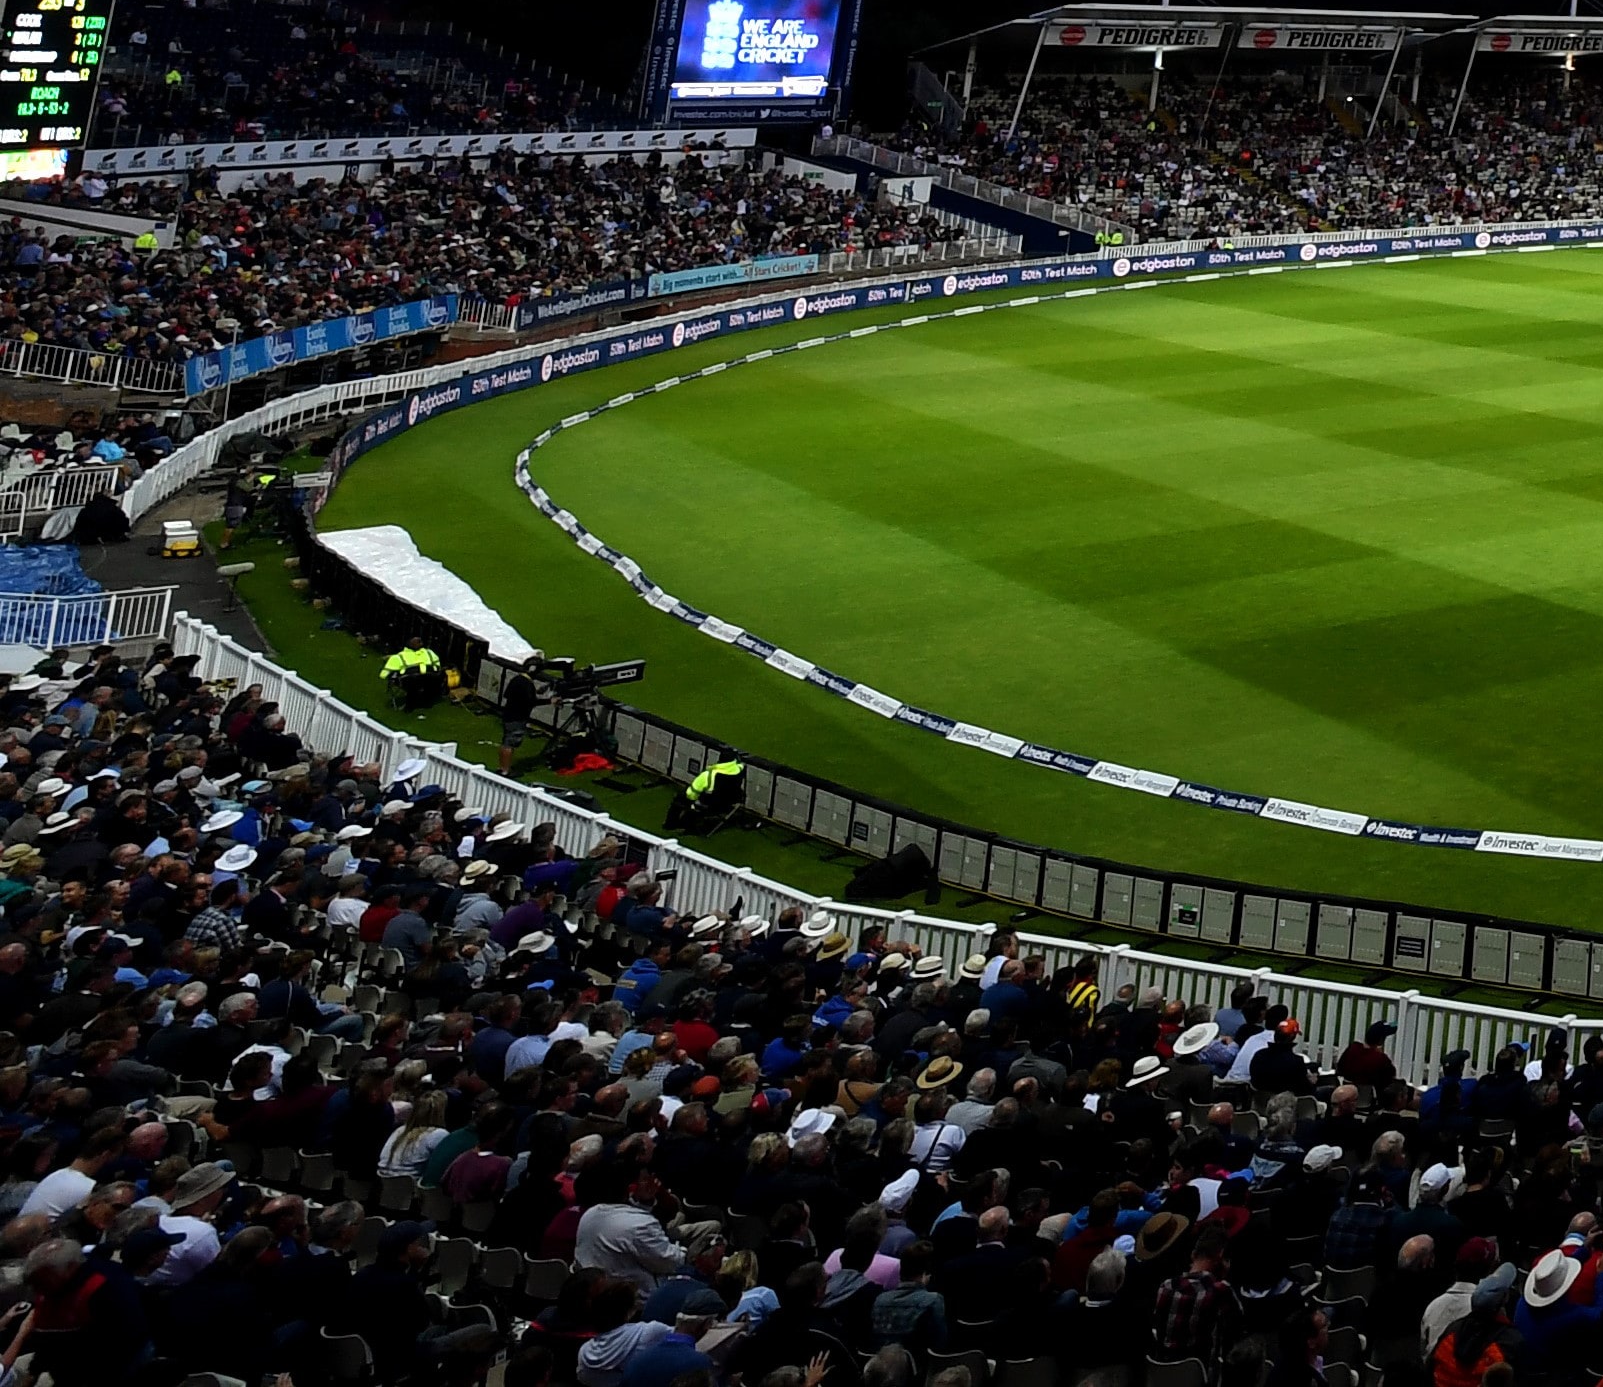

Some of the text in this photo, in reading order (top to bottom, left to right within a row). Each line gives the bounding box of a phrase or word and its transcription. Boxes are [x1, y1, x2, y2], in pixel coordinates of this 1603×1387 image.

[743, 20, 804, 34] WE ARE
[740, 34, 818, 48] ENGLAND
[1098, 28, 1197, 45] PEDIGREE
[1286, 31, 1378, 48] PEDIGREE
[1521, 36, 1602, 51] PEDIGREE
[738, 49, 805, 63] CRICKET
[1492, 231, 1546, 245] edgbaston
[1581, 227, 1599, 237] Test
[1318, 243, 1377, 258] edgbaston
[1414, 238, 1433, 249] Test
[1434, 237, 1462, 247] Match
[1132, 256, 1195, 273] edgbaston
[1209, 249, 1285, 264] 50th Test Match
[957, 272, 1008, 291] edgbaston
[1021, 265, 1098, 281] 50th Test Match
[807, 295, 856, 314] edgbaston
[746, 306, 784, 323] Test Match
[685, 319, 721, 338] edgbaston
[627, 333, 664, 353] Test Match
[553, 348, 599, 373] edgbaston
[491, 367, 532, 389] Test Match
[419, 386, 460, 415] edgbaston
[1274, 802, 1311, 821] Investec
[1374, 821, 1418, 841] Investec
[1492, 835, 1539, 852] Investec
